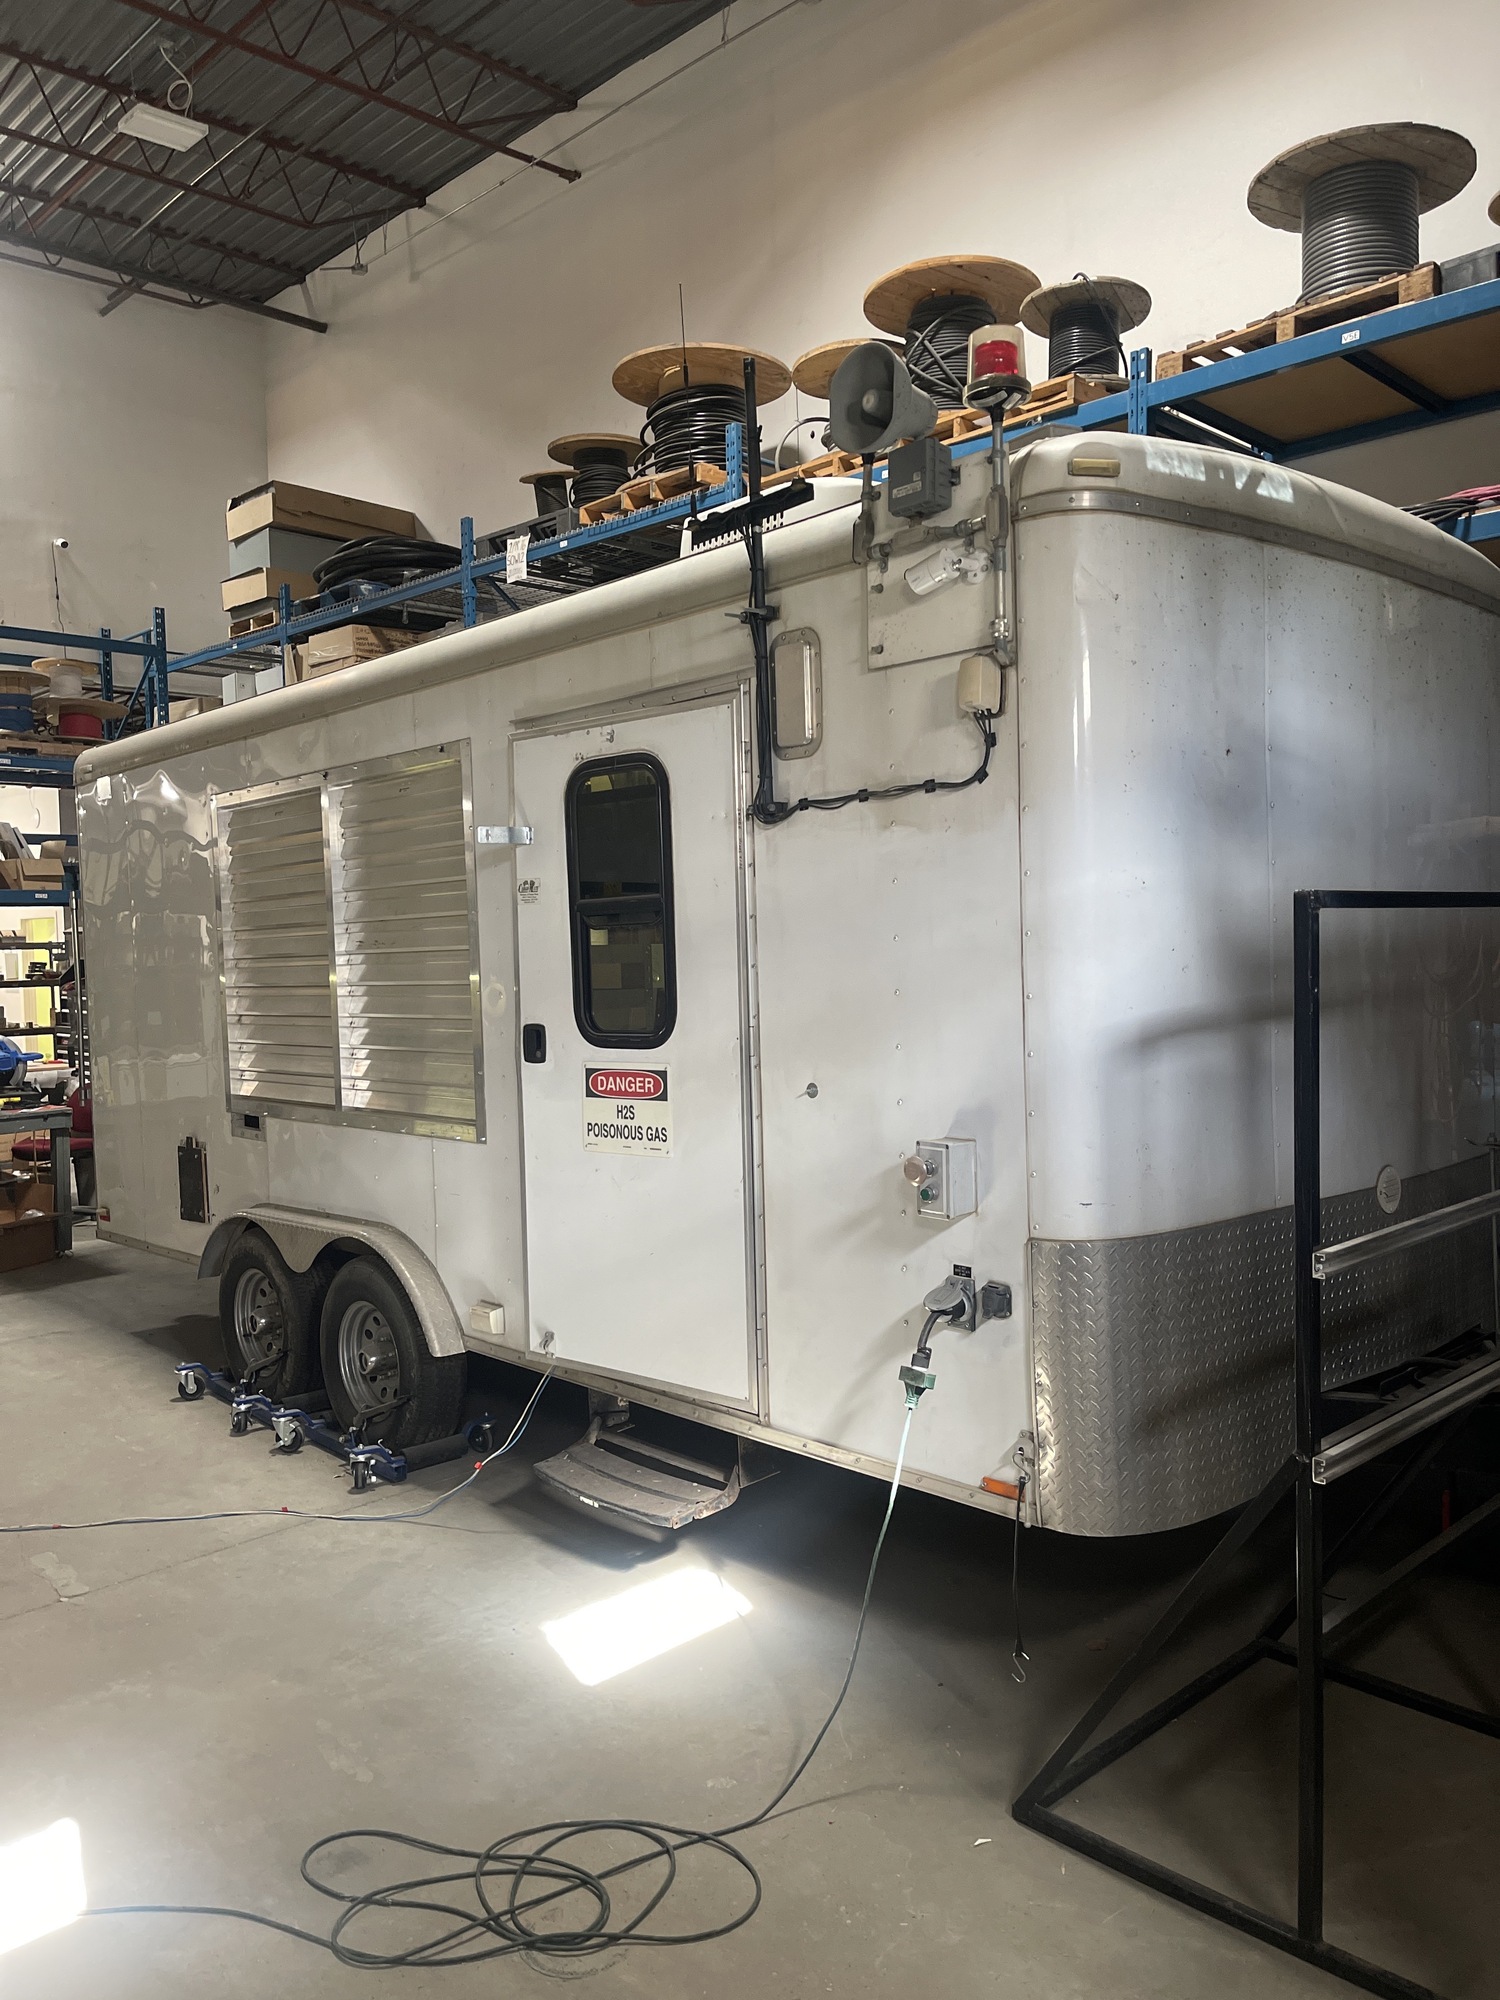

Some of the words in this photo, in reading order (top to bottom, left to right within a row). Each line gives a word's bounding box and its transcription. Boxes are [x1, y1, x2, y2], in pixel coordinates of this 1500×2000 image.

[597, 1076, 654, 1093] DANGER
[616, 1104, 635, 1120] H2S
[587, 1122, 644, 1141] POISONOUS
[646, 1126, 668, 1143] GAS
